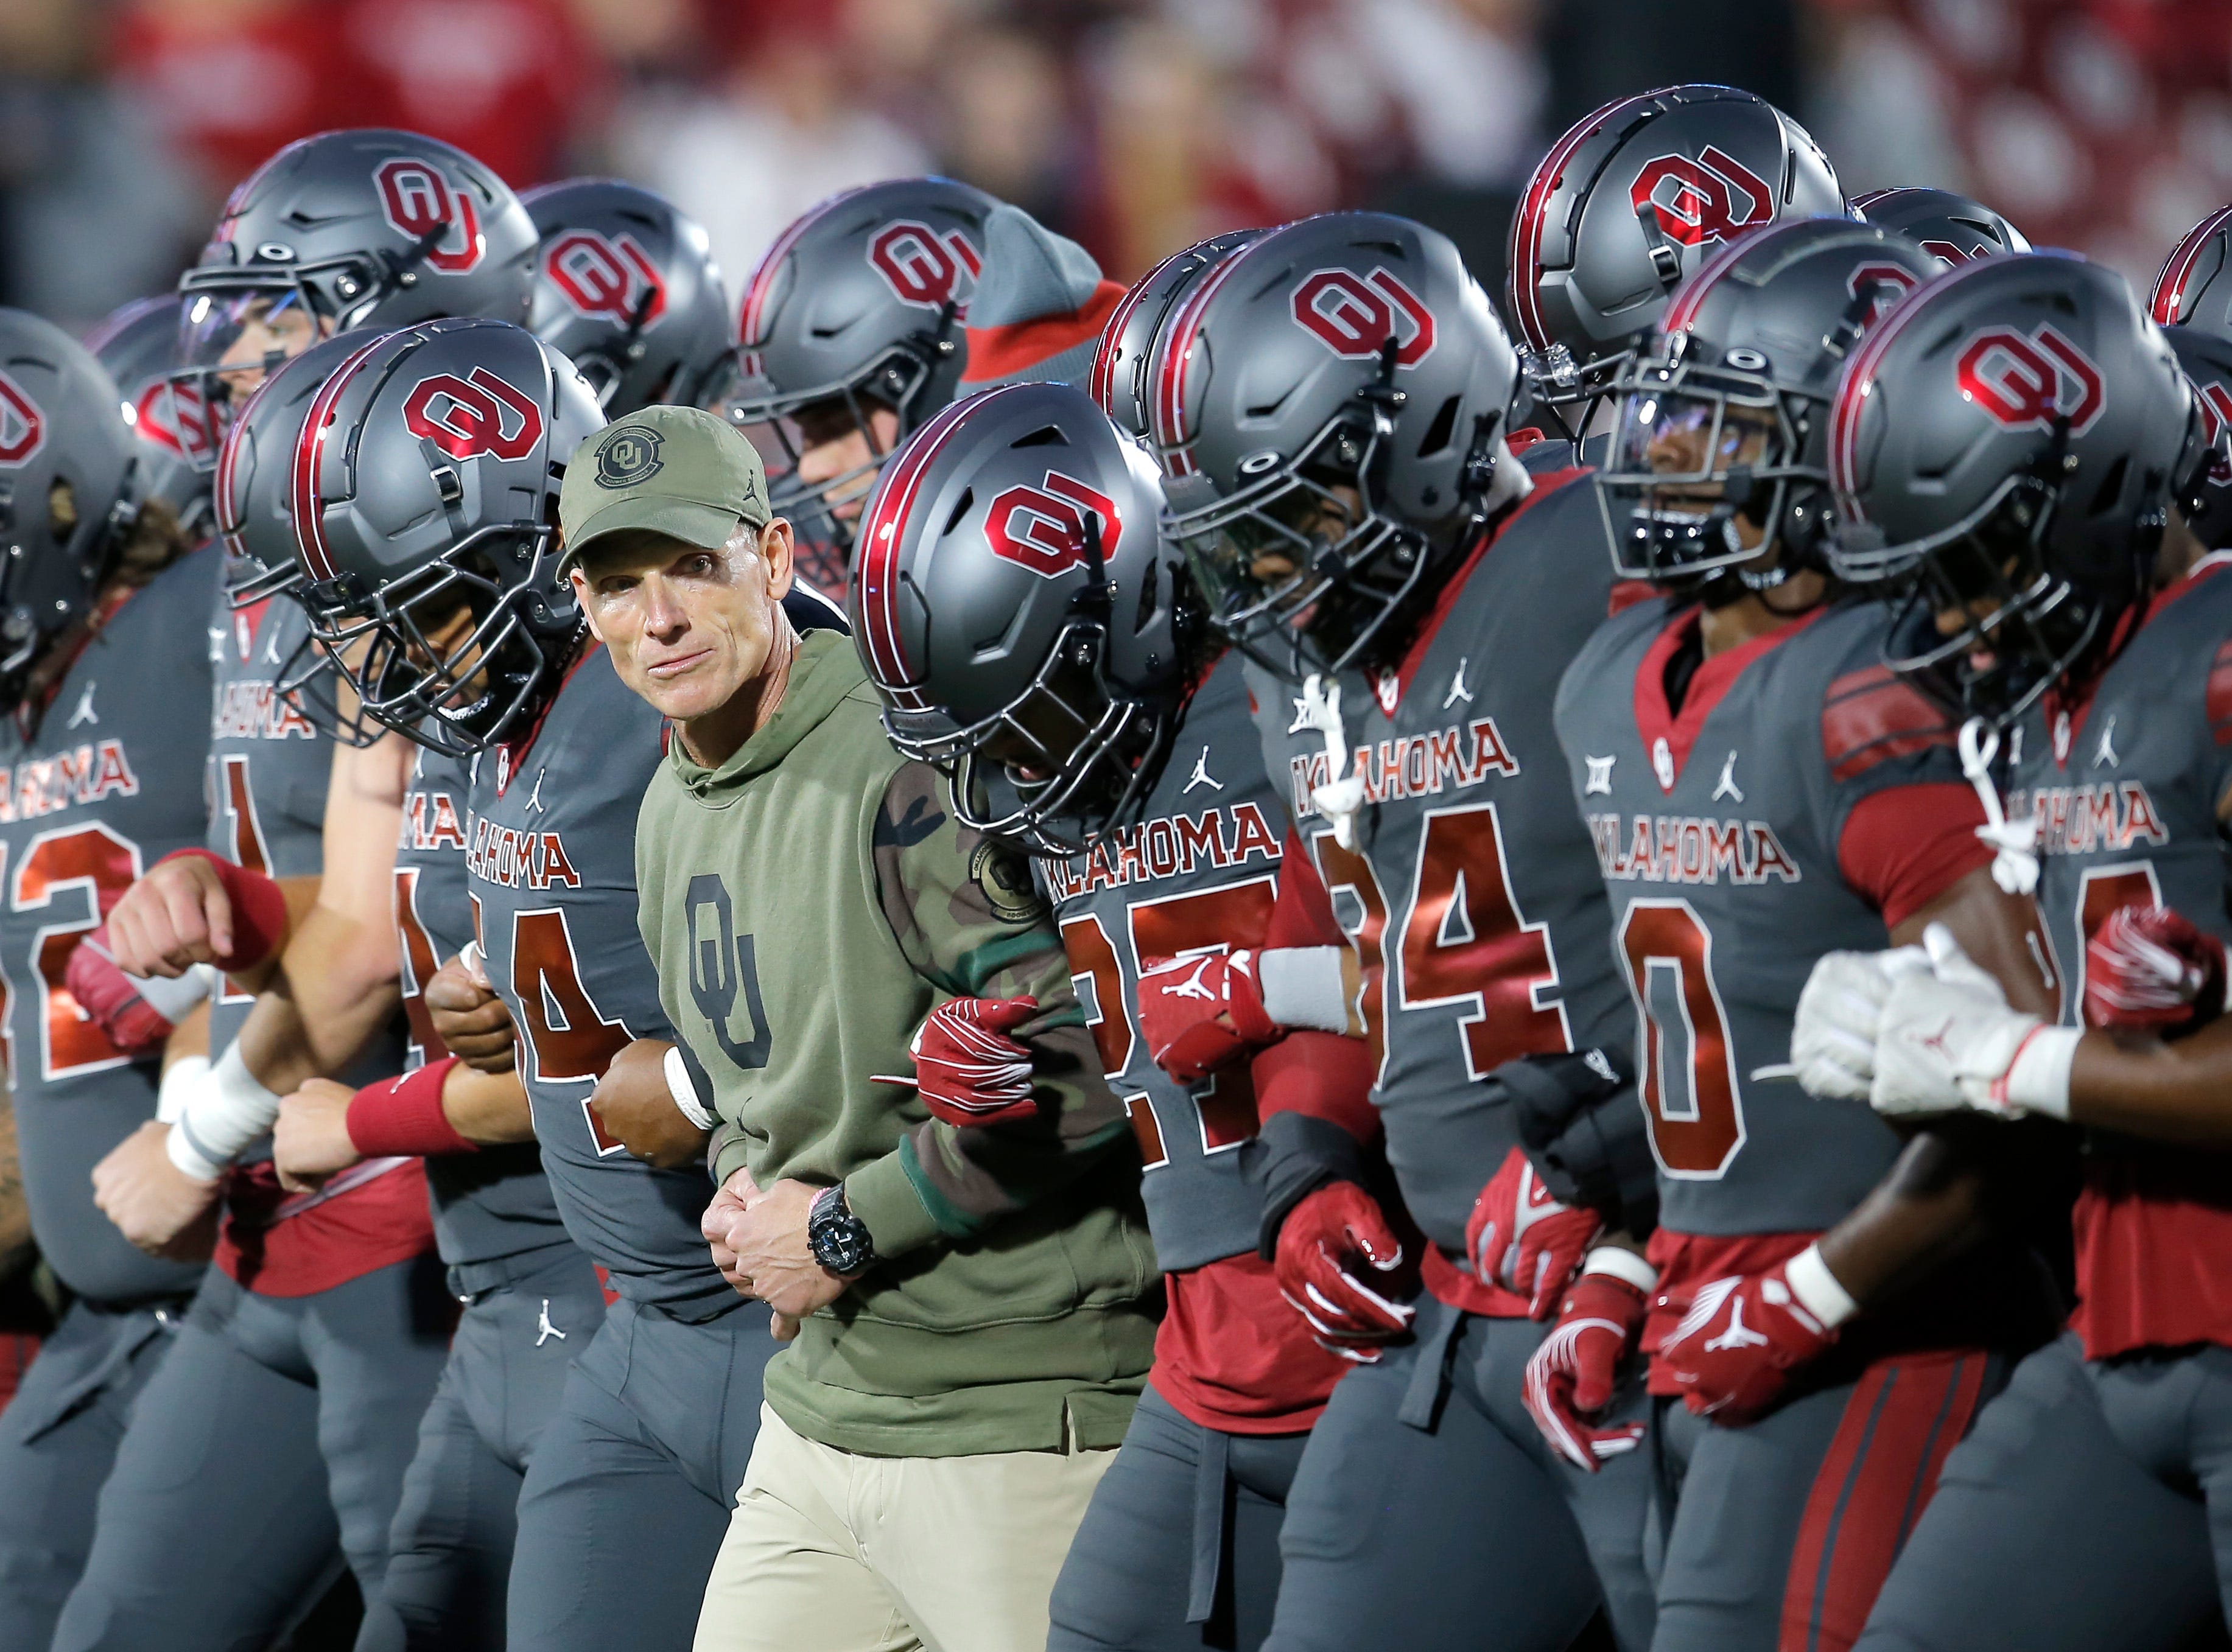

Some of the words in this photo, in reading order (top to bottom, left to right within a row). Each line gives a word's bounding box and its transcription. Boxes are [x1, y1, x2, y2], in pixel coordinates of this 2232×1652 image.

[1289, 265, 1437, 372] OU
[402, 365, 545, 463] OU
[1956, 320, 2107, 439] OU
[611, 439, 642, 471] OU
[982, 469, 1125, 580] OU
[684, 872, 773, 1070] OU
[1616, 897, 1749, 1181] 0
